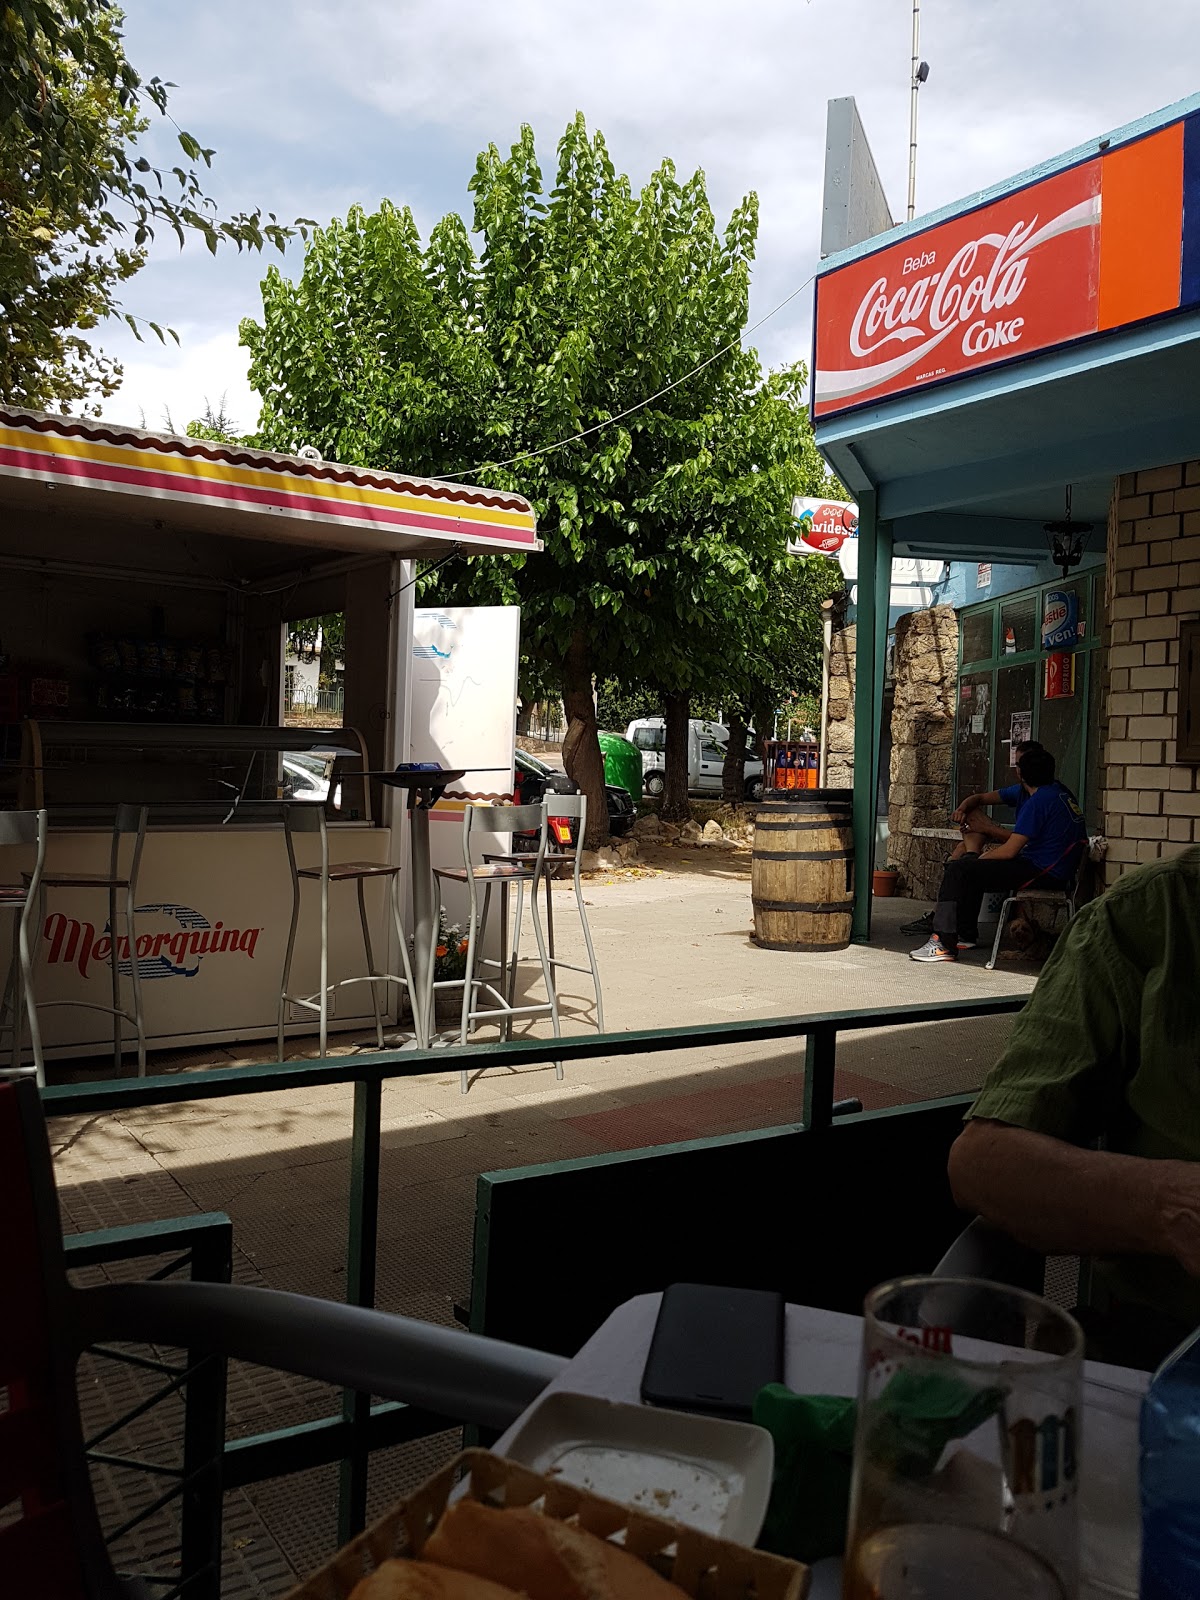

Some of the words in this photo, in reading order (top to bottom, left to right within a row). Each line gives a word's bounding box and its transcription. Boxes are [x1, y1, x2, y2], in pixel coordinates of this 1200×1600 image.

[902, 251, 936, 275] Beba
[850, 213, 1038, 357] Coca-Cola
[962, 317, 1025, 357] Coke
[915, 371, 935, 381] MARCAS
